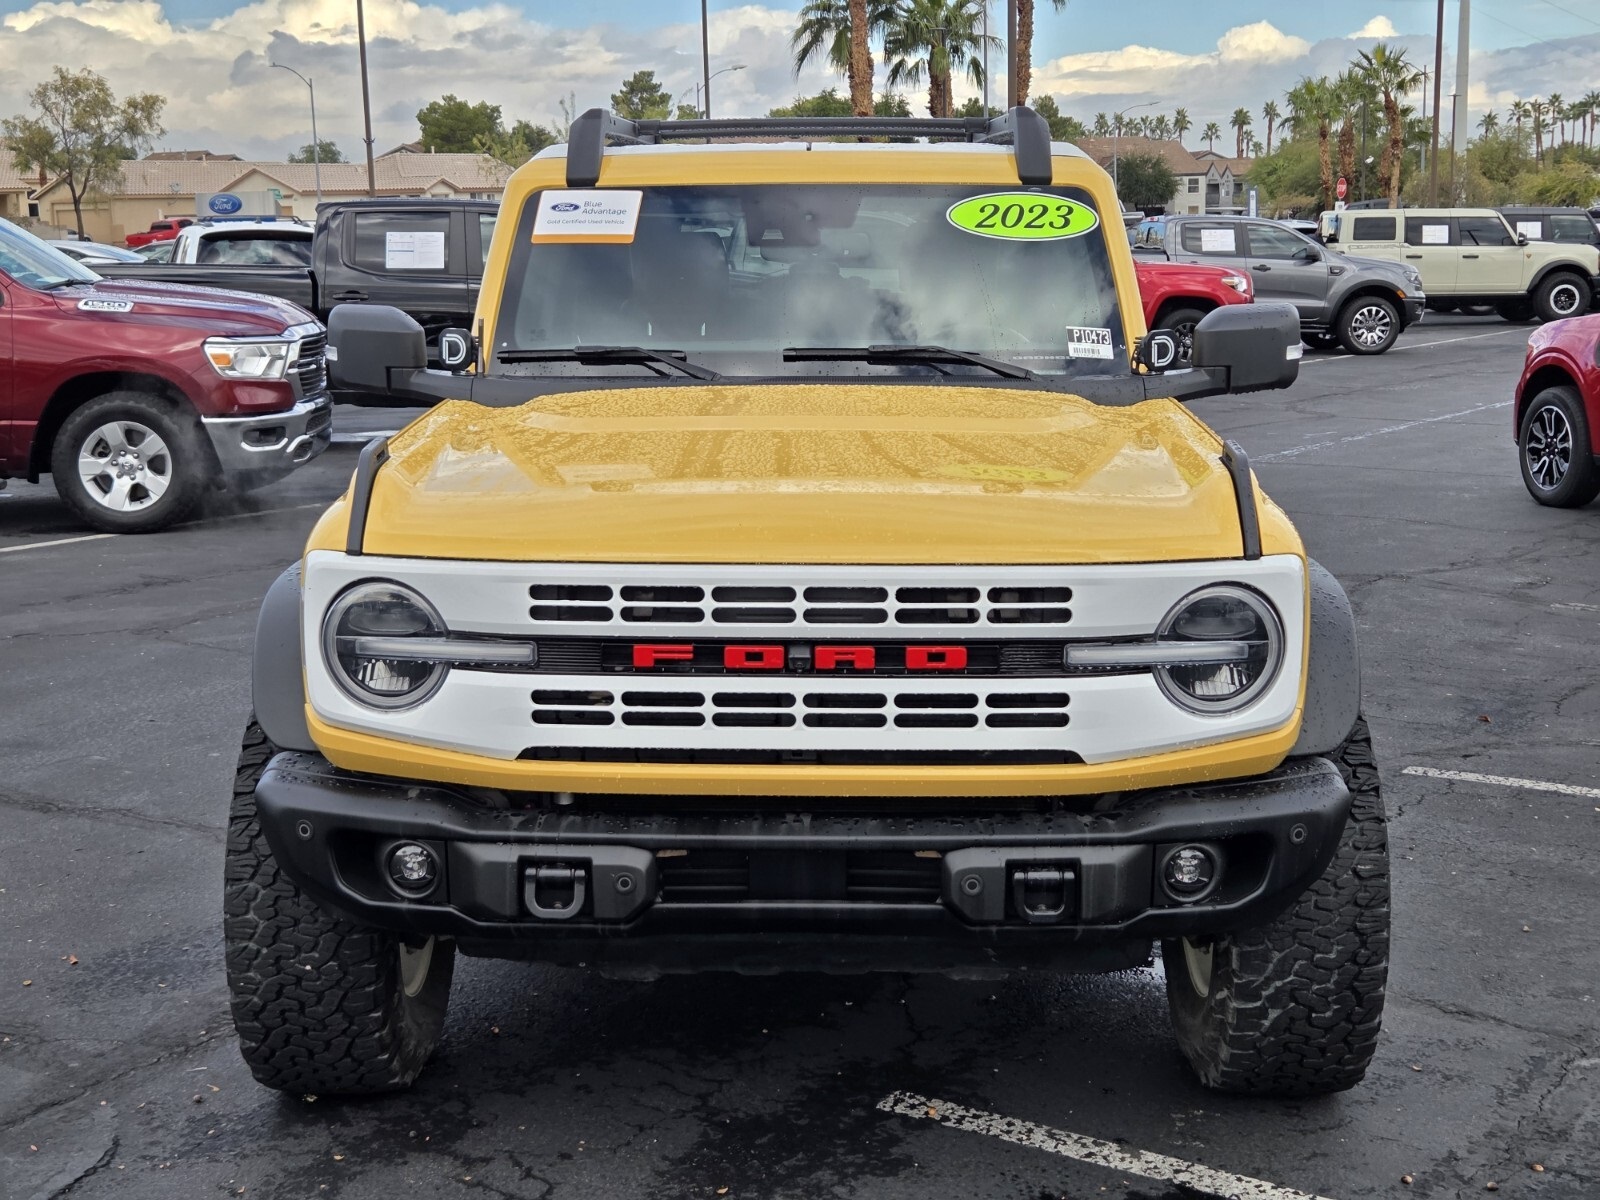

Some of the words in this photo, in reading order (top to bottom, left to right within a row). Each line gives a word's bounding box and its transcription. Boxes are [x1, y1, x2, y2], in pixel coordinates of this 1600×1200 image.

[555, 203, 576, 212] Ford
[583, 200, 603, 208] Blue
[581, 207, 627, 215] Advantage
[974, 203, 1075, 230] 2023
[1073, 329, 1110, 345] P10473
[633, 644, 967, 669] FORD
